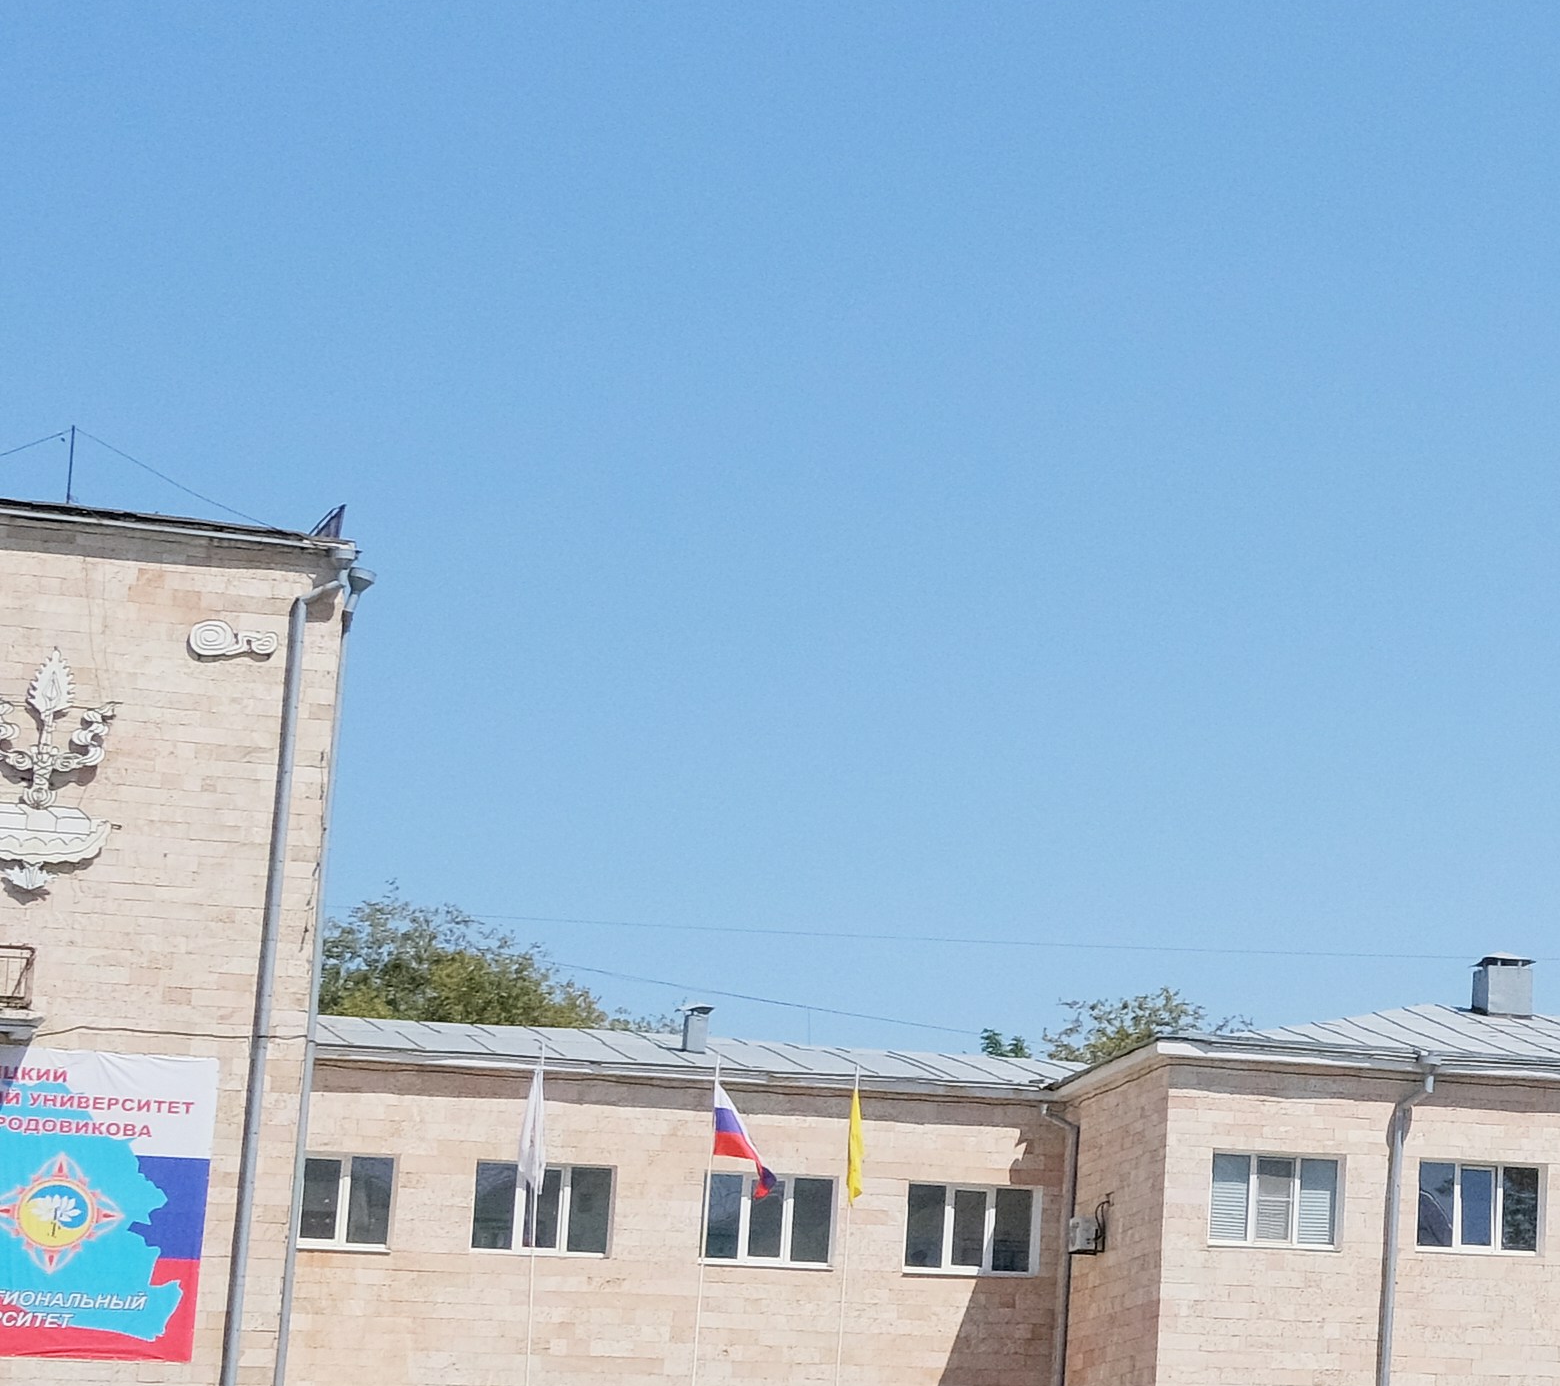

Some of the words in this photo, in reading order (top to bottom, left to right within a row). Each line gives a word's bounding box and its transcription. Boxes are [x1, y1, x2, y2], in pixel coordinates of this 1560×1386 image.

[0, 1065, 67, 1083] ЦКИЙ
[29, 1092, 195, 1115] УНИВЕРСИТЕТ
[0, 1311, 75, 1329] СИТЕТ
